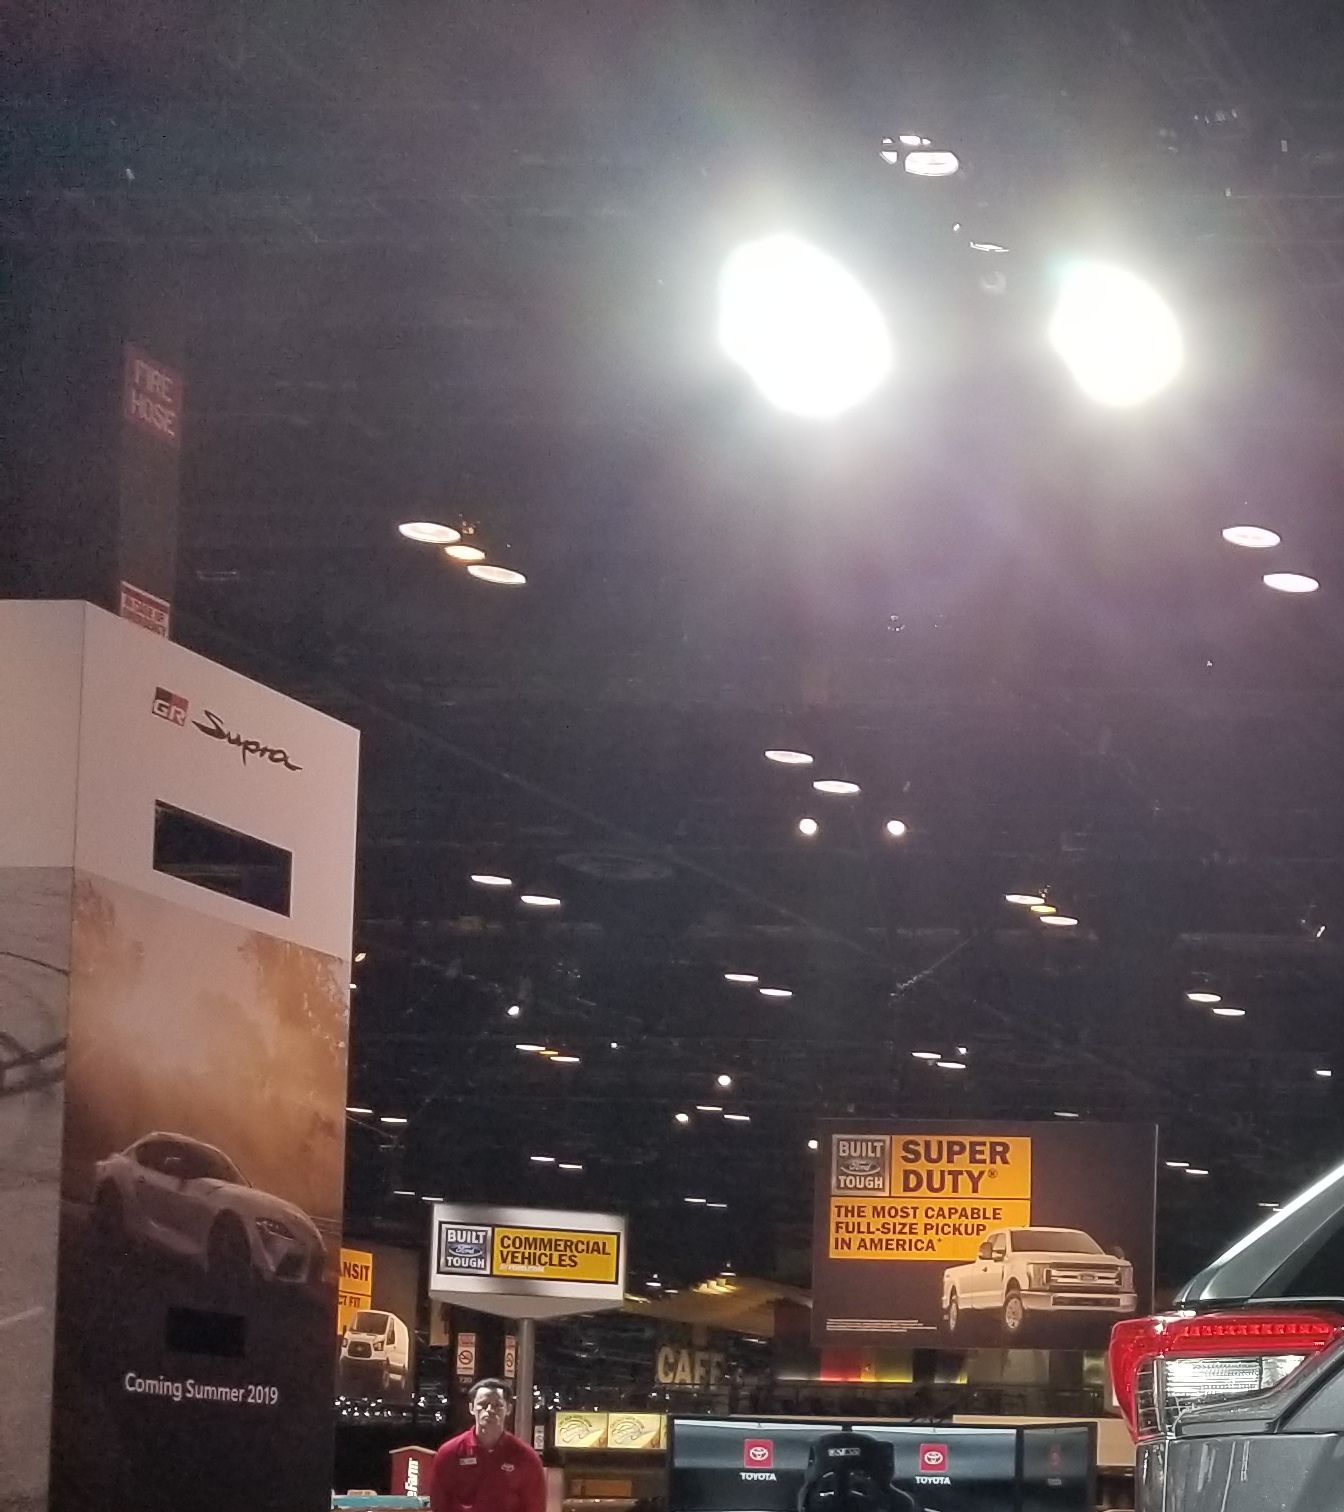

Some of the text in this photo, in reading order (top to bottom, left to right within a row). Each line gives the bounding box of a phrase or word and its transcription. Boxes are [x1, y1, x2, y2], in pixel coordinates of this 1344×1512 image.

[153, 699, 303, 767] GR Supra
[838, 1140, 884, 1158] BUILT
[900, 1139, 1010, 1165] SUPER
[838, 1175, 884, 1190] TOUGH
[834, 1205, 1003, 1221] THE MOST CAPABLE
[447, 1229, 487, 1245] BUILT
[834, 1222, 987, 1236] FULL-SIZE PICKUP
[500, 1234, 611, 1256] COMMERCIAL
[834, 1238, 852, 1251] IN
[446, 1256, 485, 1269] TOUGH
[499, 1249, 578, 1268] VEHICLES
[125, 1373, 279, 1404] Coming Summer 2019
[740, 1472, 777, 1482] TOYOTA
[915, 1476, 951, 1486] TOYOTA
